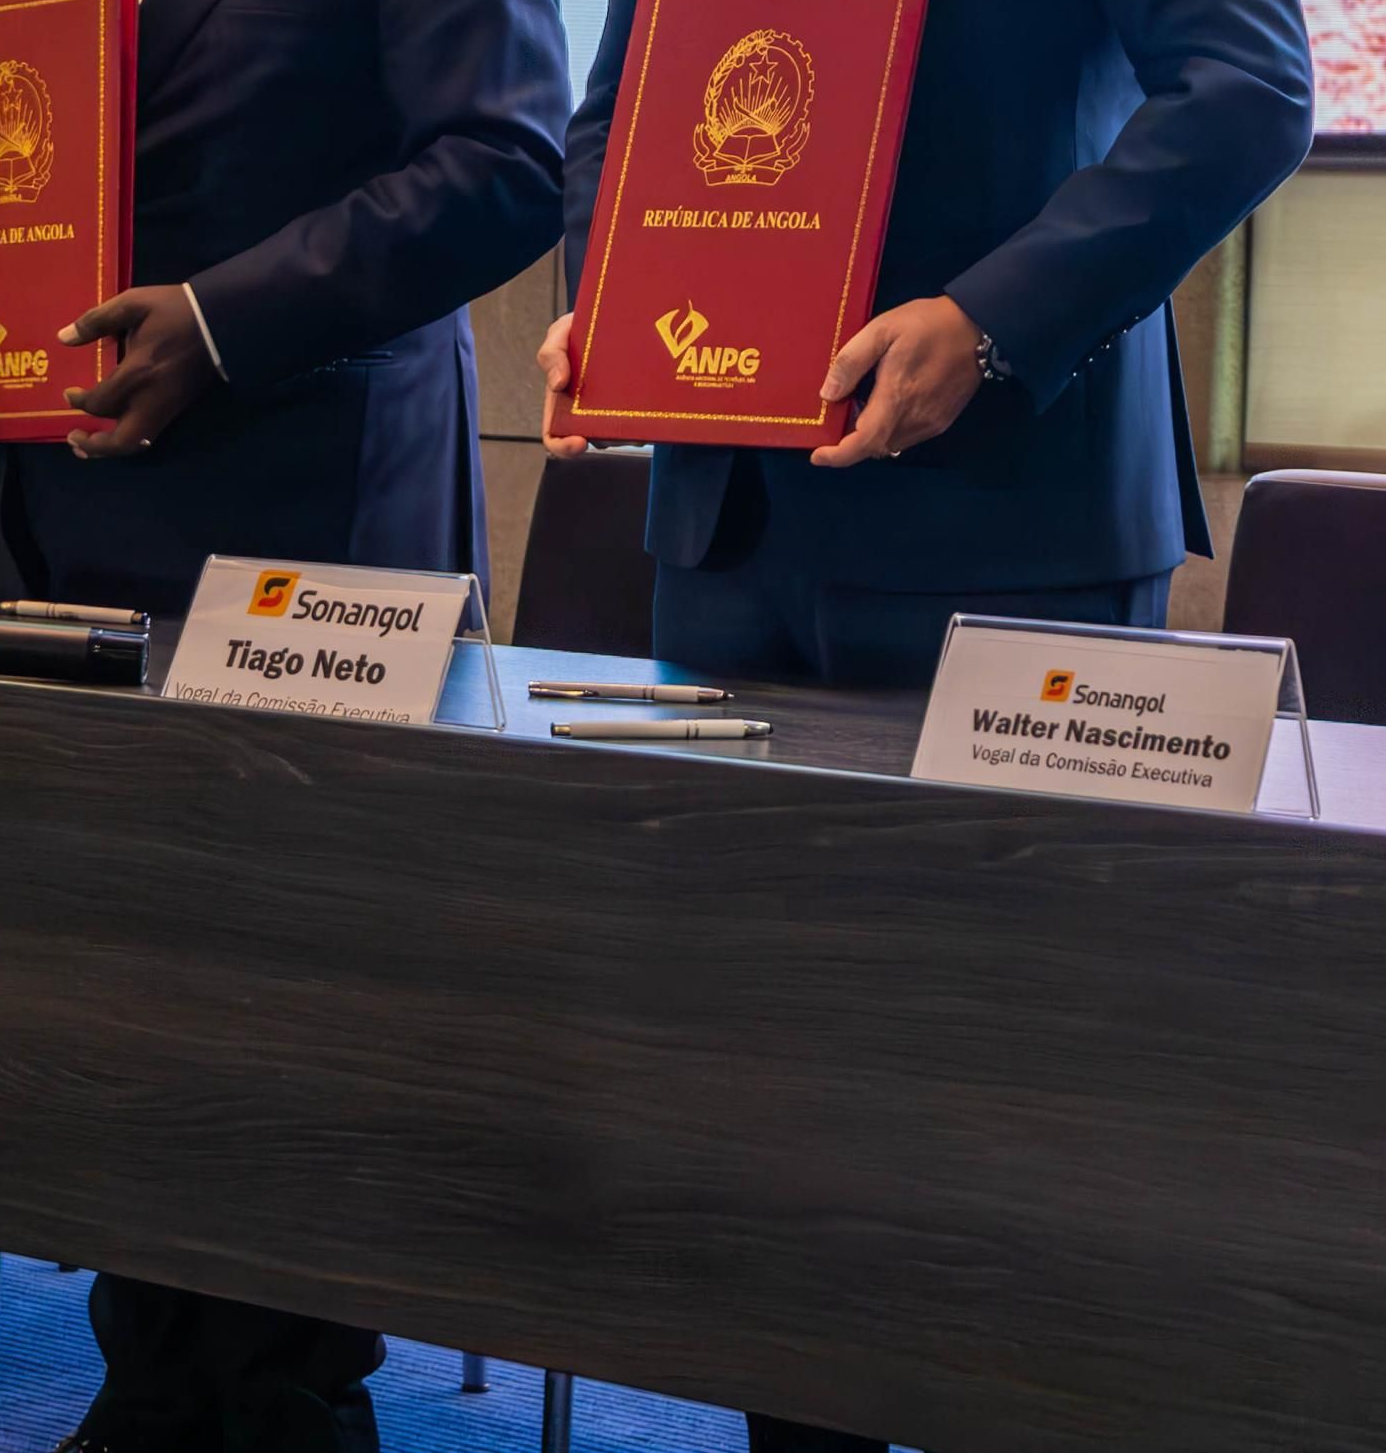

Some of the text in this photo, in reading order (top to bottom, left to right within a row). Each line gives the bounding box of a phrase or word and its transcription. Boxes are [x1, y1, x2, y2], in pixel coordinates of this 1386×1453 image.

[643, 204, 820, 230] REPÚBLICA DE ANGOLA
[8, 227, 25, 245] DE
[25, 223, 75, 243] ANGOLA
[677, 346, 760, 376] ANPG
[292, 590, 424, 637] Sonangol
[226, 639, 386, 685] Tiago Neto
[176, 682, 219, 702] Vogal
[221, 689, 242, 706] da
[246, 691, 326, 715] Comissão
[1073, 684, 1166, 717] Sonangol
[973, 708, 1231, 760] Walter Nascimento
[972, 744, 1213, 788] Vogal da Comissão Executiva
